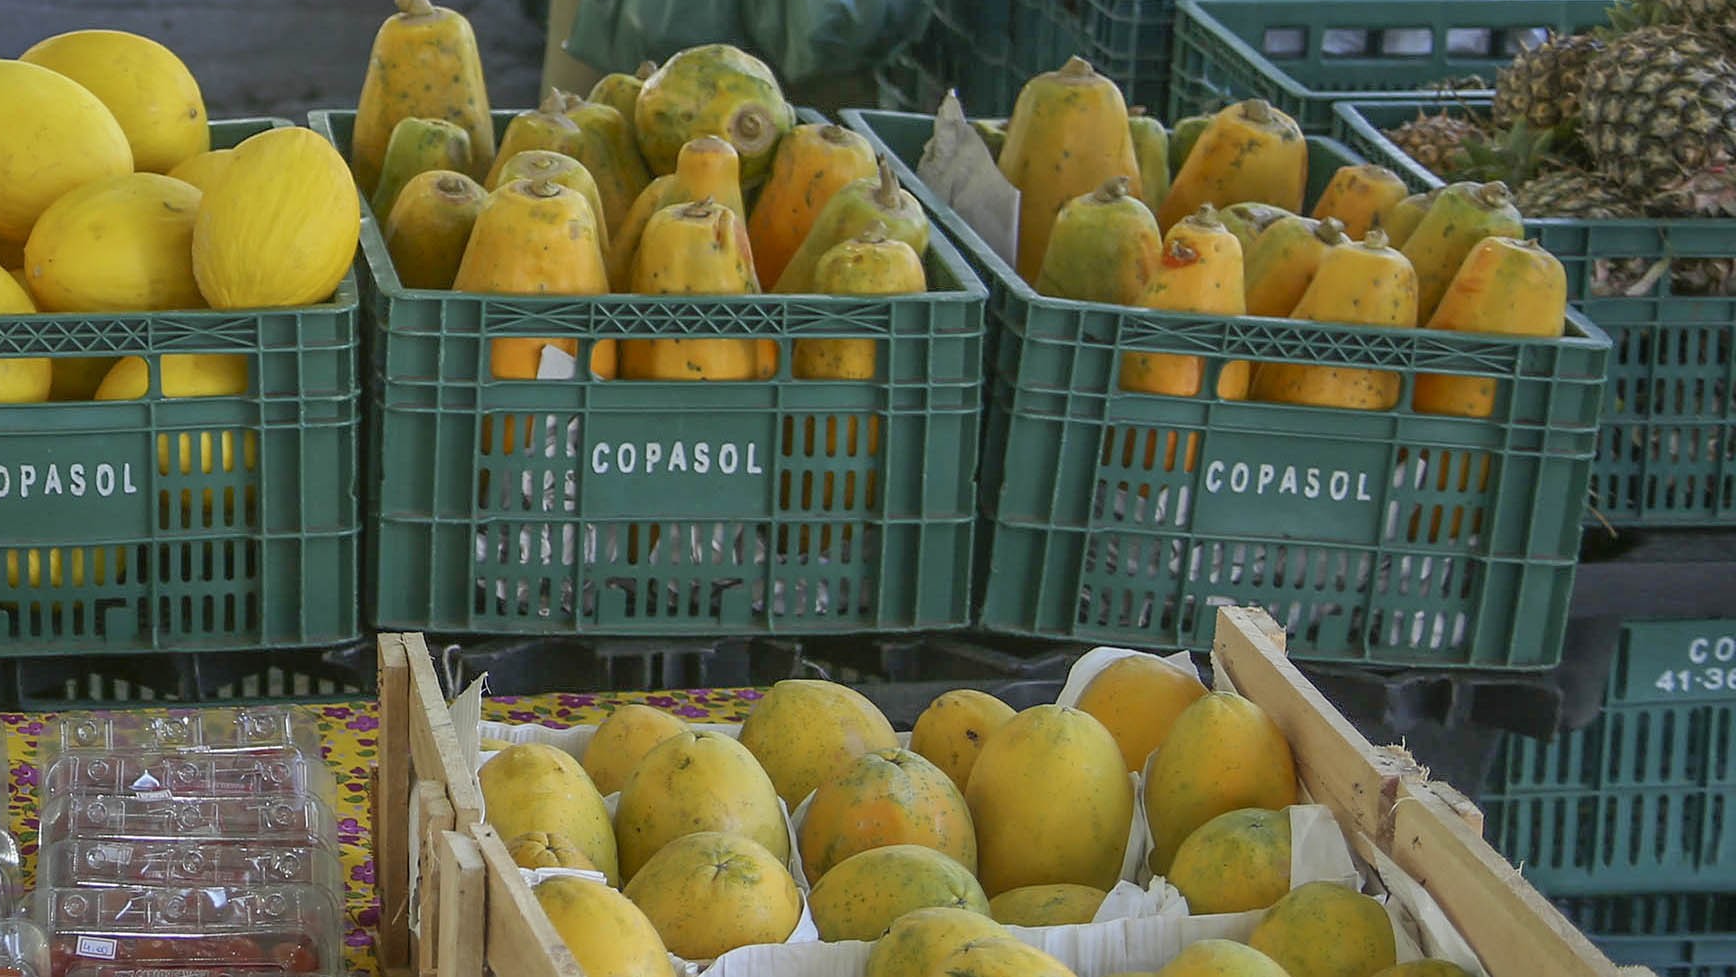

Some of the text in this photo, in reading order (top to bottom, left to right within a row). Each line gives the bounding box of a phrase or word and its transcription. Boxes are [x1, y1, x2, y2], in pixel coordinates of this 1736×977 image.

[592, 440, 762, 474] COPASOL
[1206, 460, 1371, 501] COPASOL
[1690, 636, 1736, 664] CO
